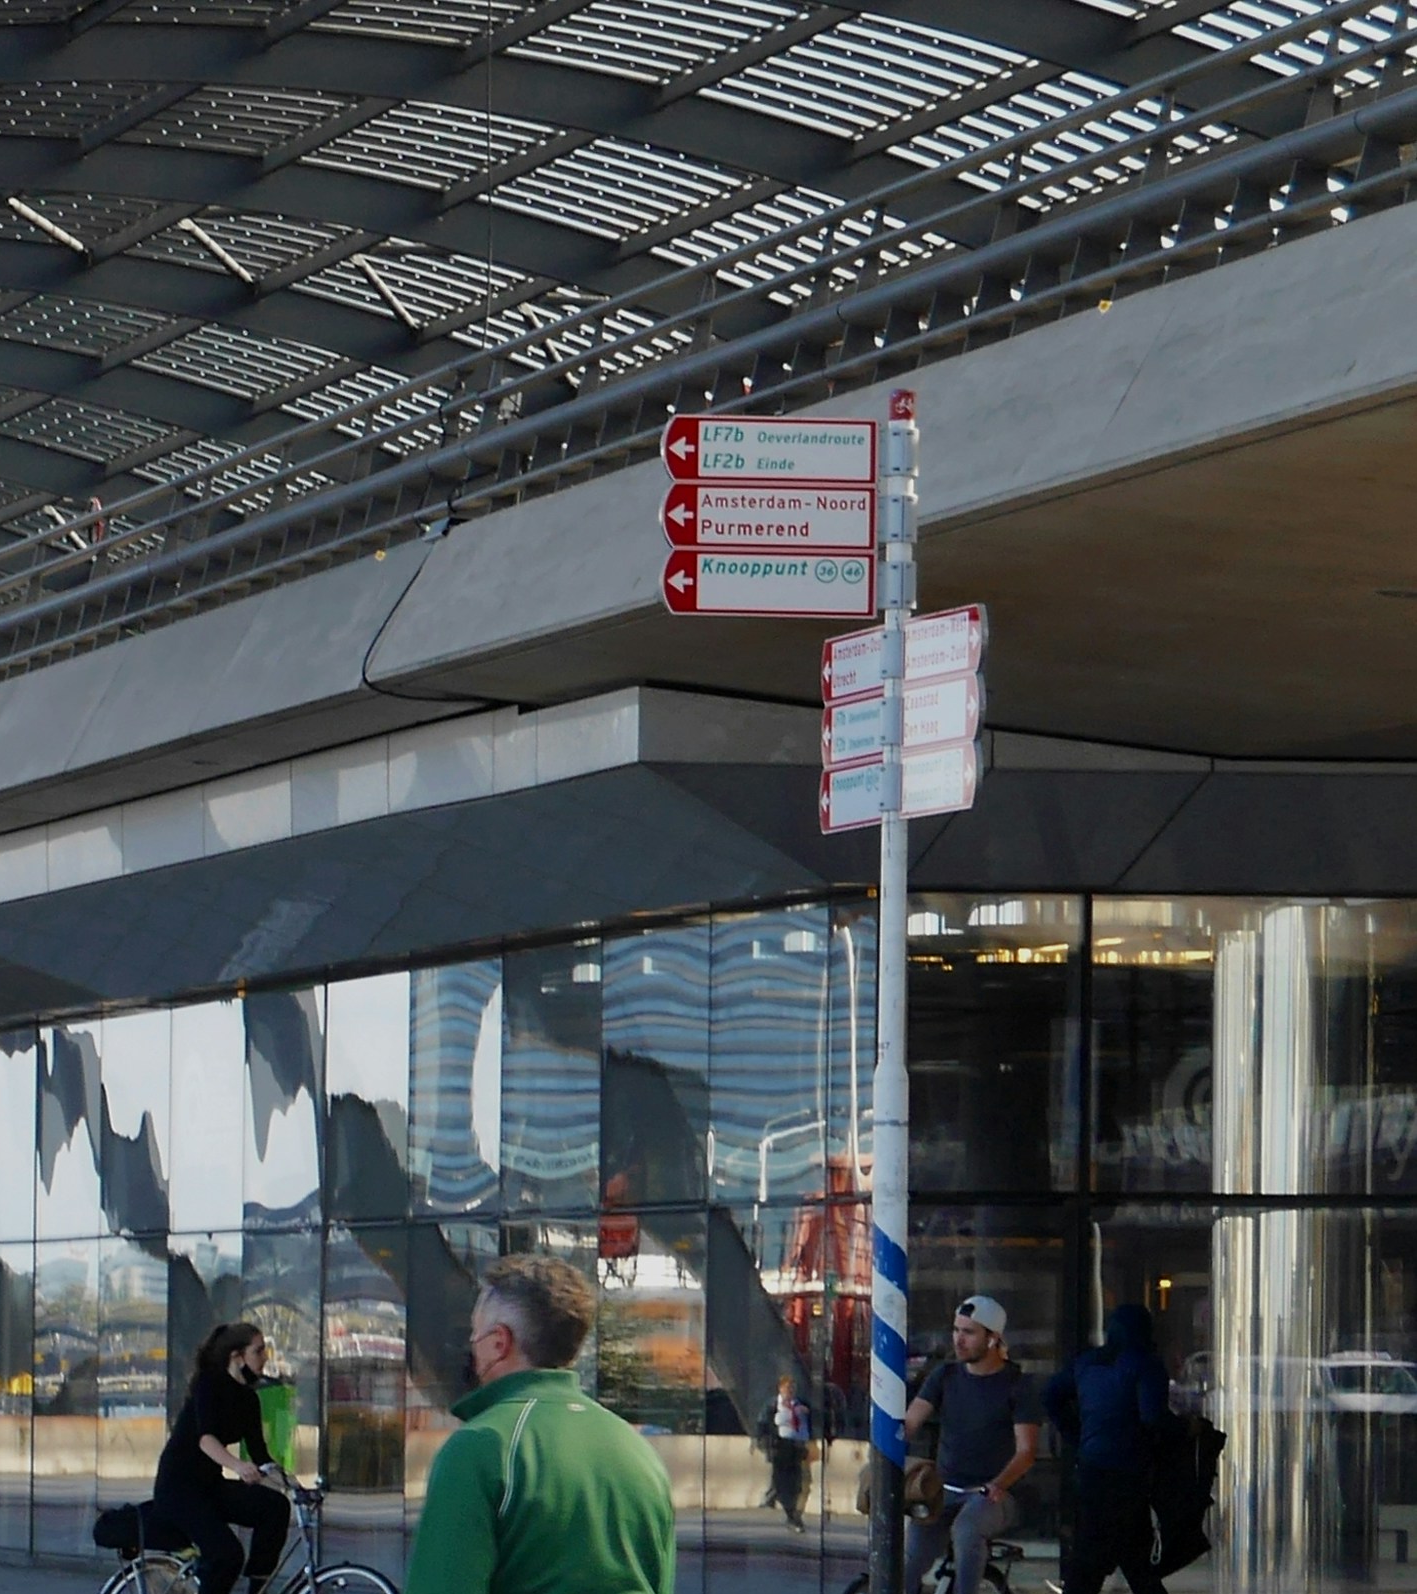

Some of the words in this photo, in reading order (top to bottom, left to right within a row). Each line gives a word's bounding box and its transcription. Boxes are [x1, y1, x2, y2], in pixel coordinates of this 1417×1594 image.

[703, 426, 745, 443] LF7b
[757, 431, 865, 446] Oeverlandroute
[703, 453, 745, 469] LF2b
[757, 458, 795, 470] Einde
[701, 519, 810, 537] Purmerend
[701, 559, 808, 578] Knooppunt
[833, 636, 882, 661] Amsterdam-Oos
